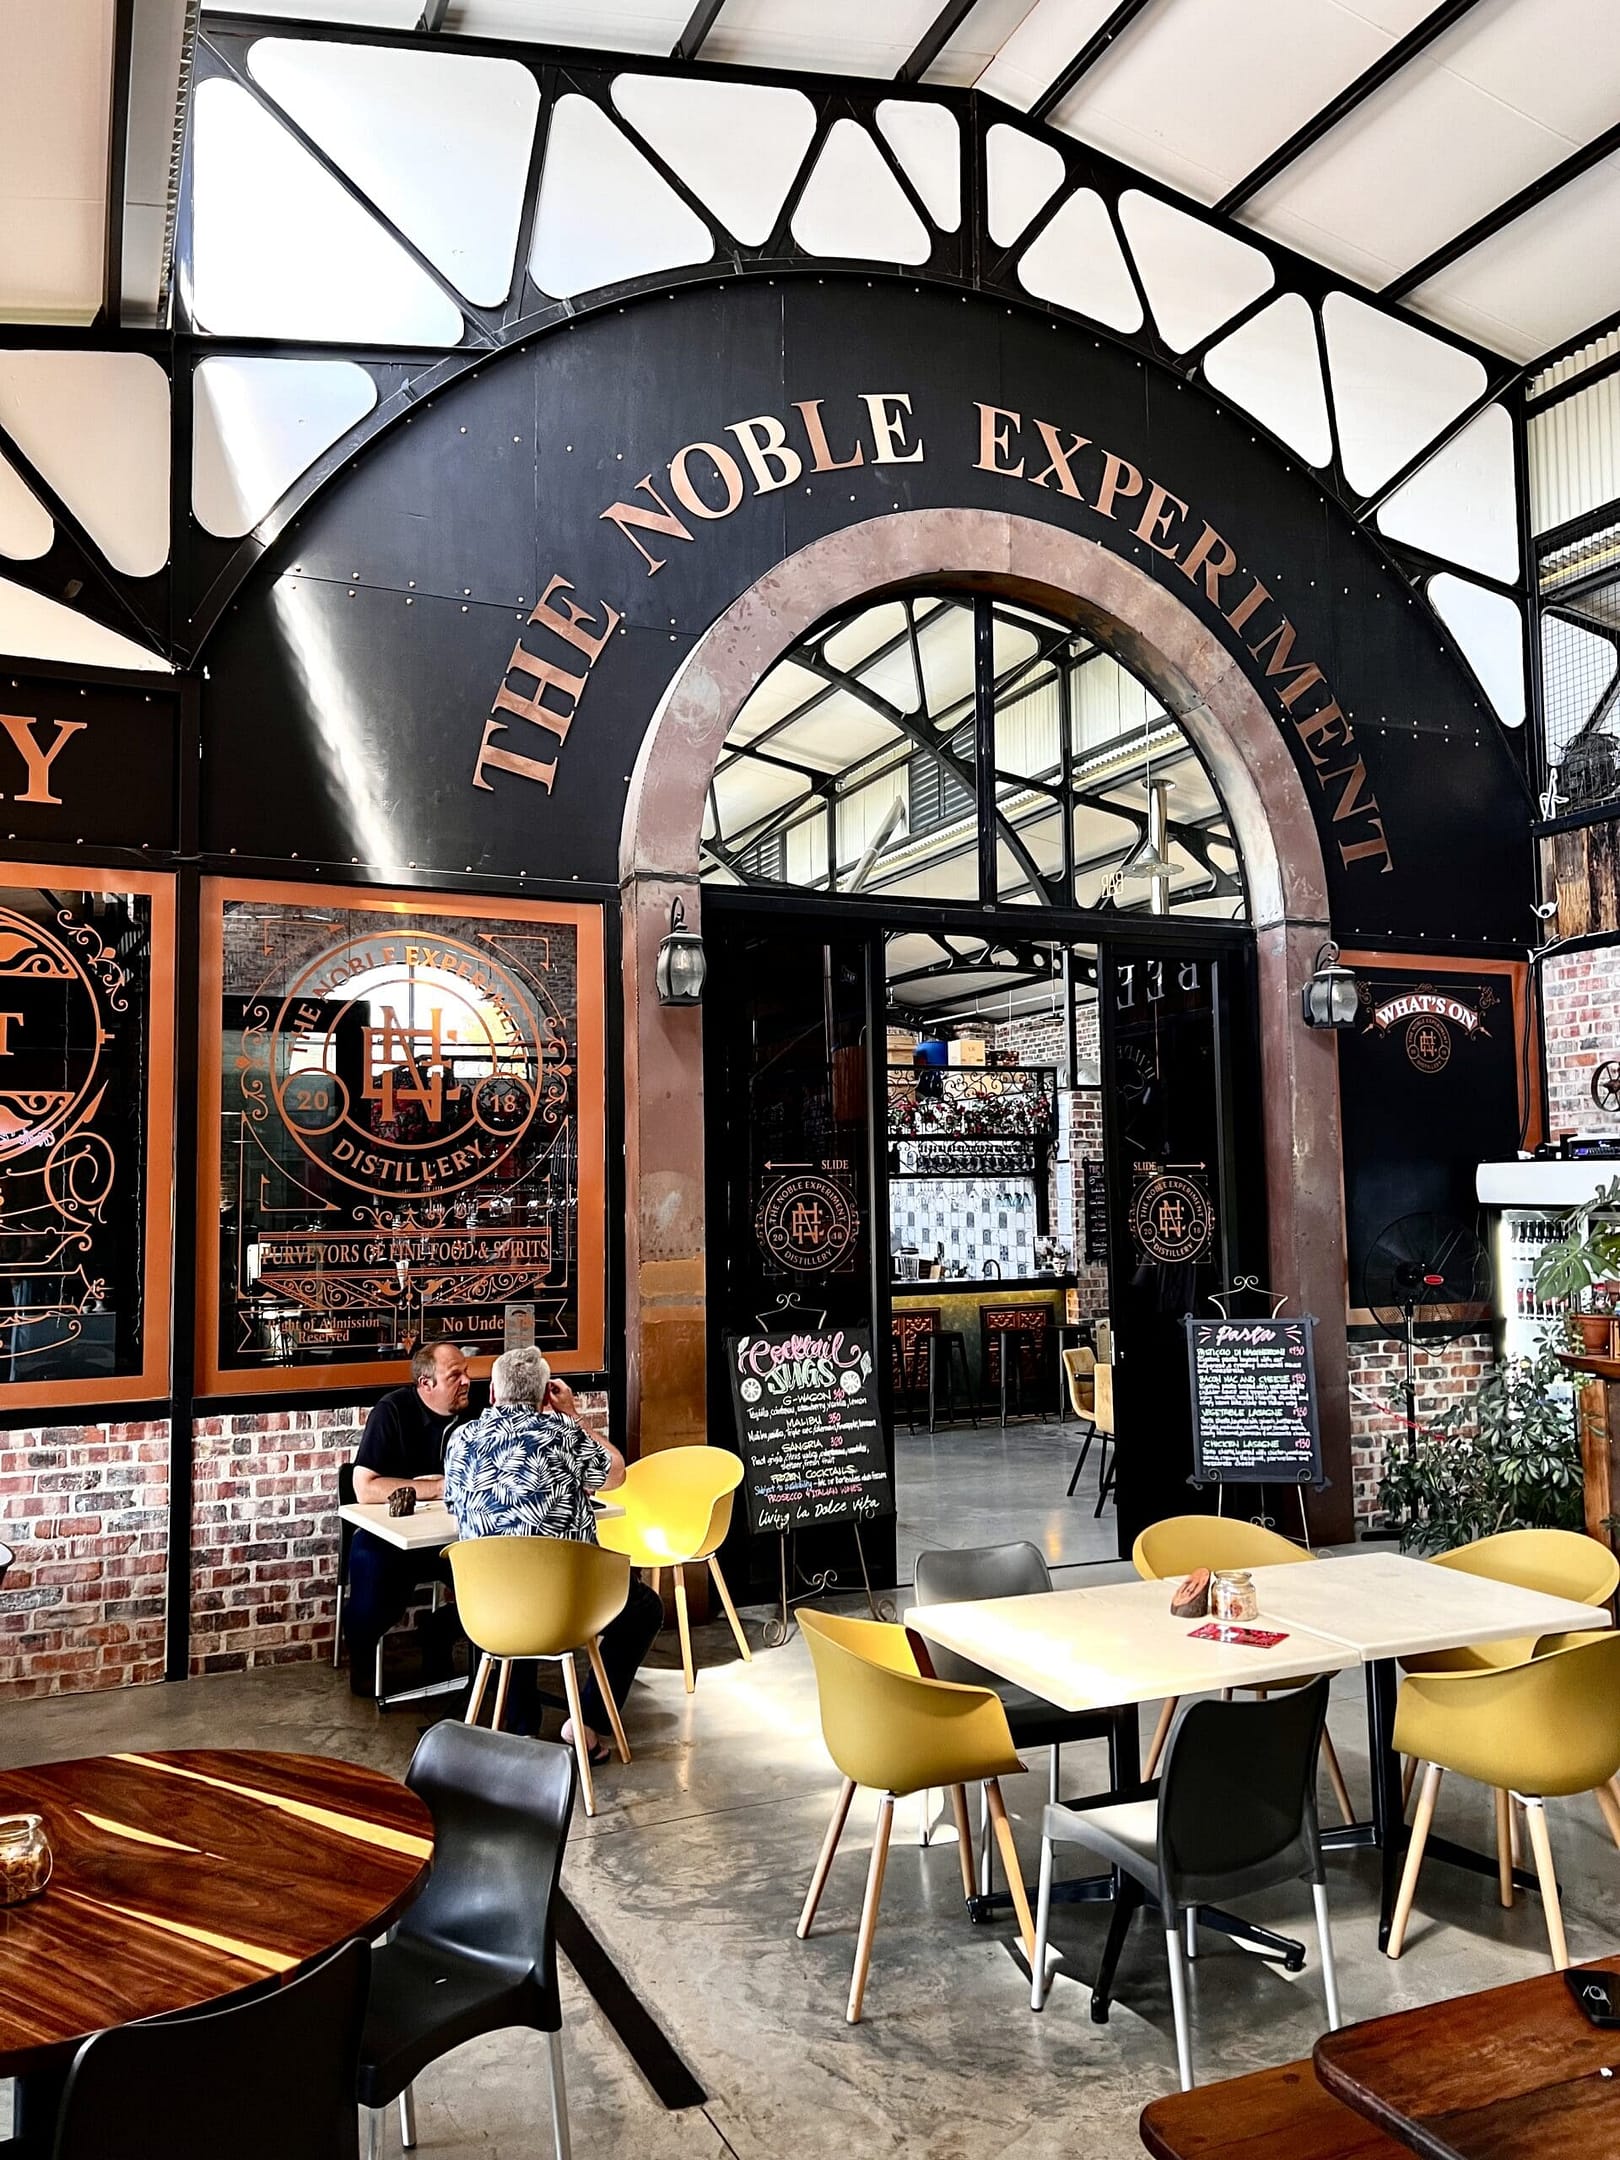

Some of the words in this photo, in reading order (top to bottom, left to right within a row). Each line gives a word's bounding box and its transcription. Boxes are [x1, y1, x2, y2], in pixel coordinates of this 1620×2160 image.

[471, 575, 622, 795] THE
[599, 393, 924, 576] NOBLE
[973, 402, 1399, 874] EXPERIMENT
[0, 714, 87, 805] Y
[288, 1002, 321, 1053] THE
[312, 947, 395, 1003] NOBLE
[405, 945, 527, 1060] EXPERIMENT
[1375, 995, 1445, 1025] WHAT'S
[1449, 1003, 1478, 1031] ON
[297, 1091, 329, 1110] 20
[491, 1096, 516, 1112] 18
[332, 1138, 486, 1182] DISTILLERY
[821, 1160, 849, 1170] SLIDE
[1133, 1161, 1157, 1171] SLIDE
[769, 1203, 780, 1224] THE
[778, 1181, 803, 1203] NOBLE
[805, 1180, 848, 1221] EXPERIMENT
[262, 1243, 359, 1265] PURVEYORS
[364, 1242, 384, 1263] OF
[430, 1241, 474, 1261] FOOD
[478, 1241, 489, 1258] &
[493, 1240, 549, 1260] SPIRITS
[784, 1249, 832, 1265] DISTILLERY
[1153, 1242, 1193, 1257] DISTILLERY
[303, 1316, 316, 1330] of
[319, 1315, 380, 1330] Admission
[442, 1317, 463, 1332] No
[299, 1331, 350, 1344] Reserved
[765, 1359, 837, 1394] JUGS
[1240, 1375, 1255, 1383] AND
[782, 1389, 831, 1406] G-WAGON
[786, 1415, 822, 1428] MALIBU
[828, 1412, 841, 1424] 350
[781, 1439, 823, 1453] SANGRIA
[805, 1464, 858, 1479] COCKTAILS
[767, 1491, 803, 1504] PROSECCO
